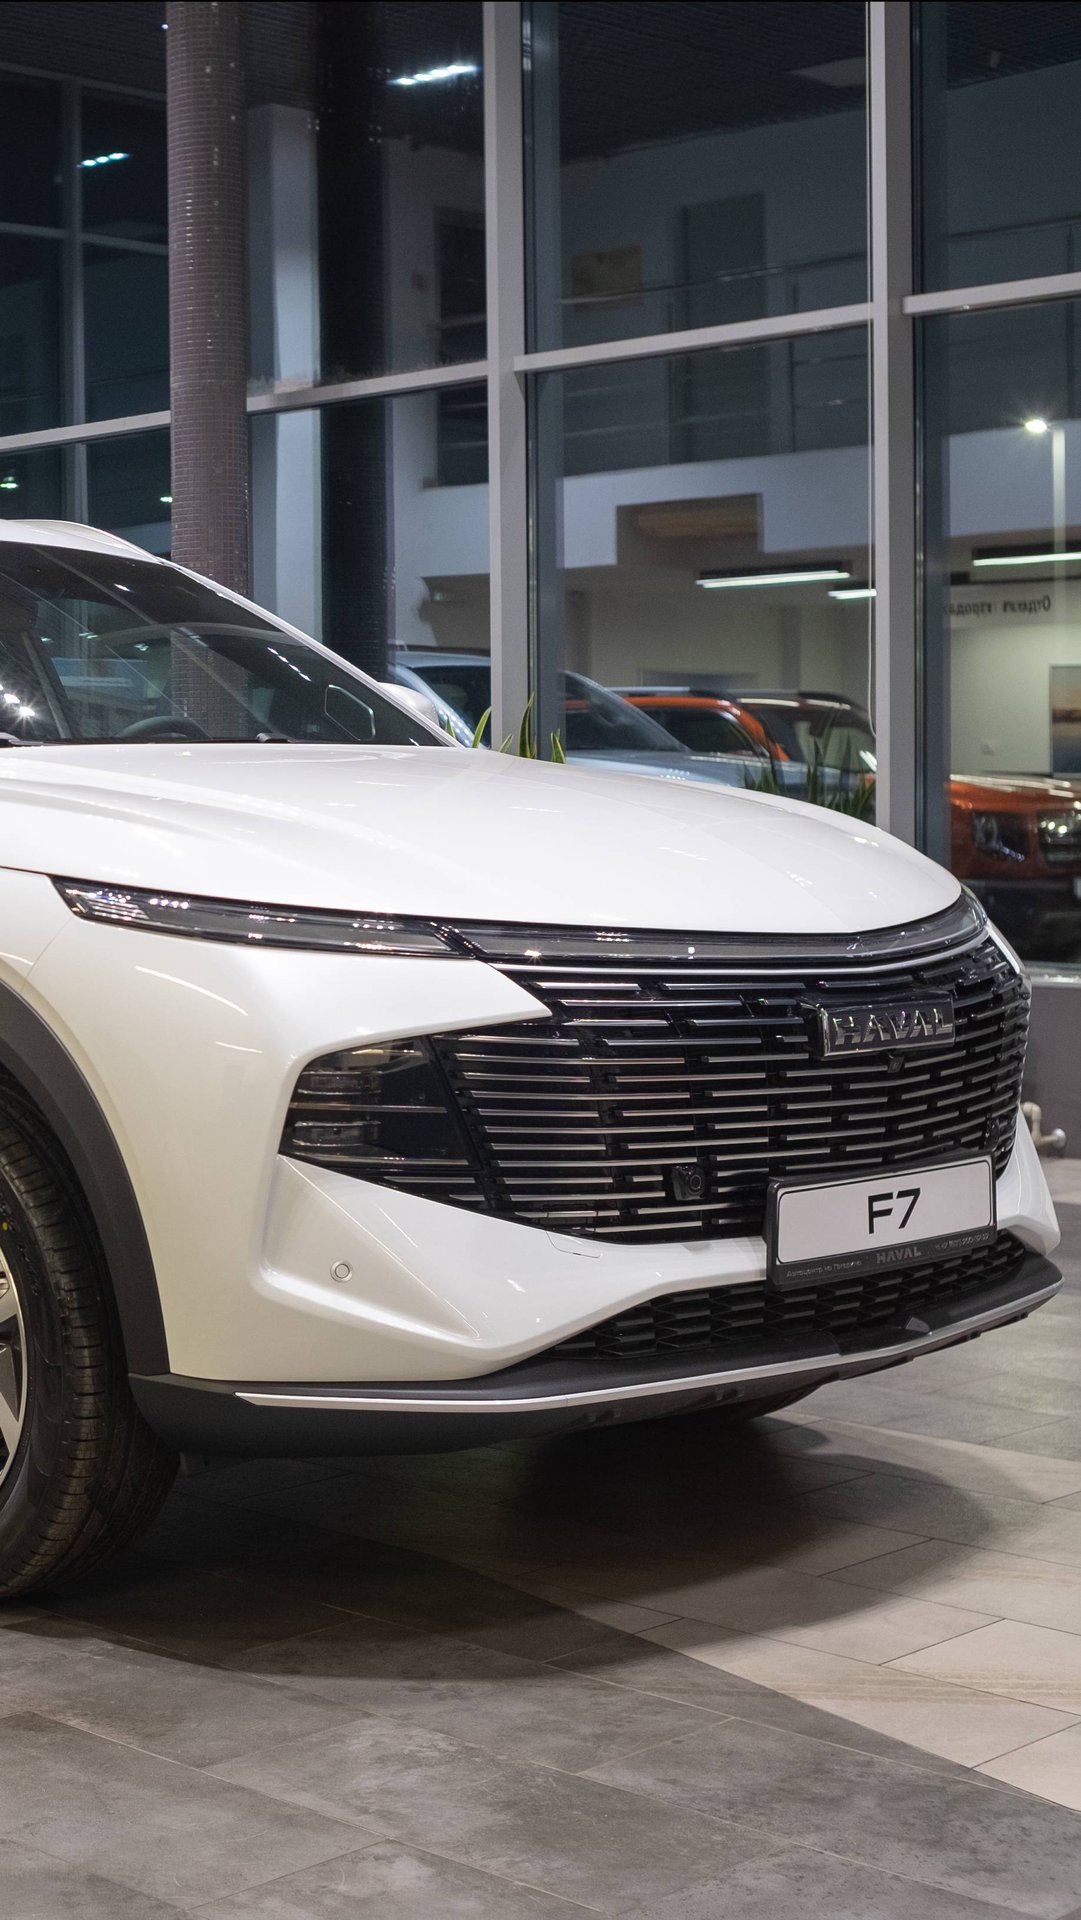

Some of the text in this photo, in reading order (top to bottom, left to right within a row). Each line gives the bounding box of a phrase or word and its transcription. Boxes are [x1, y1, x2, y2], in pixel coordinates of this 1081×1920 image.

[832, 1008, 953, 1045] HAVAL
[867, 1187, 921, 1235] F7
[876, 1246, 922, 1264] HAVAL
